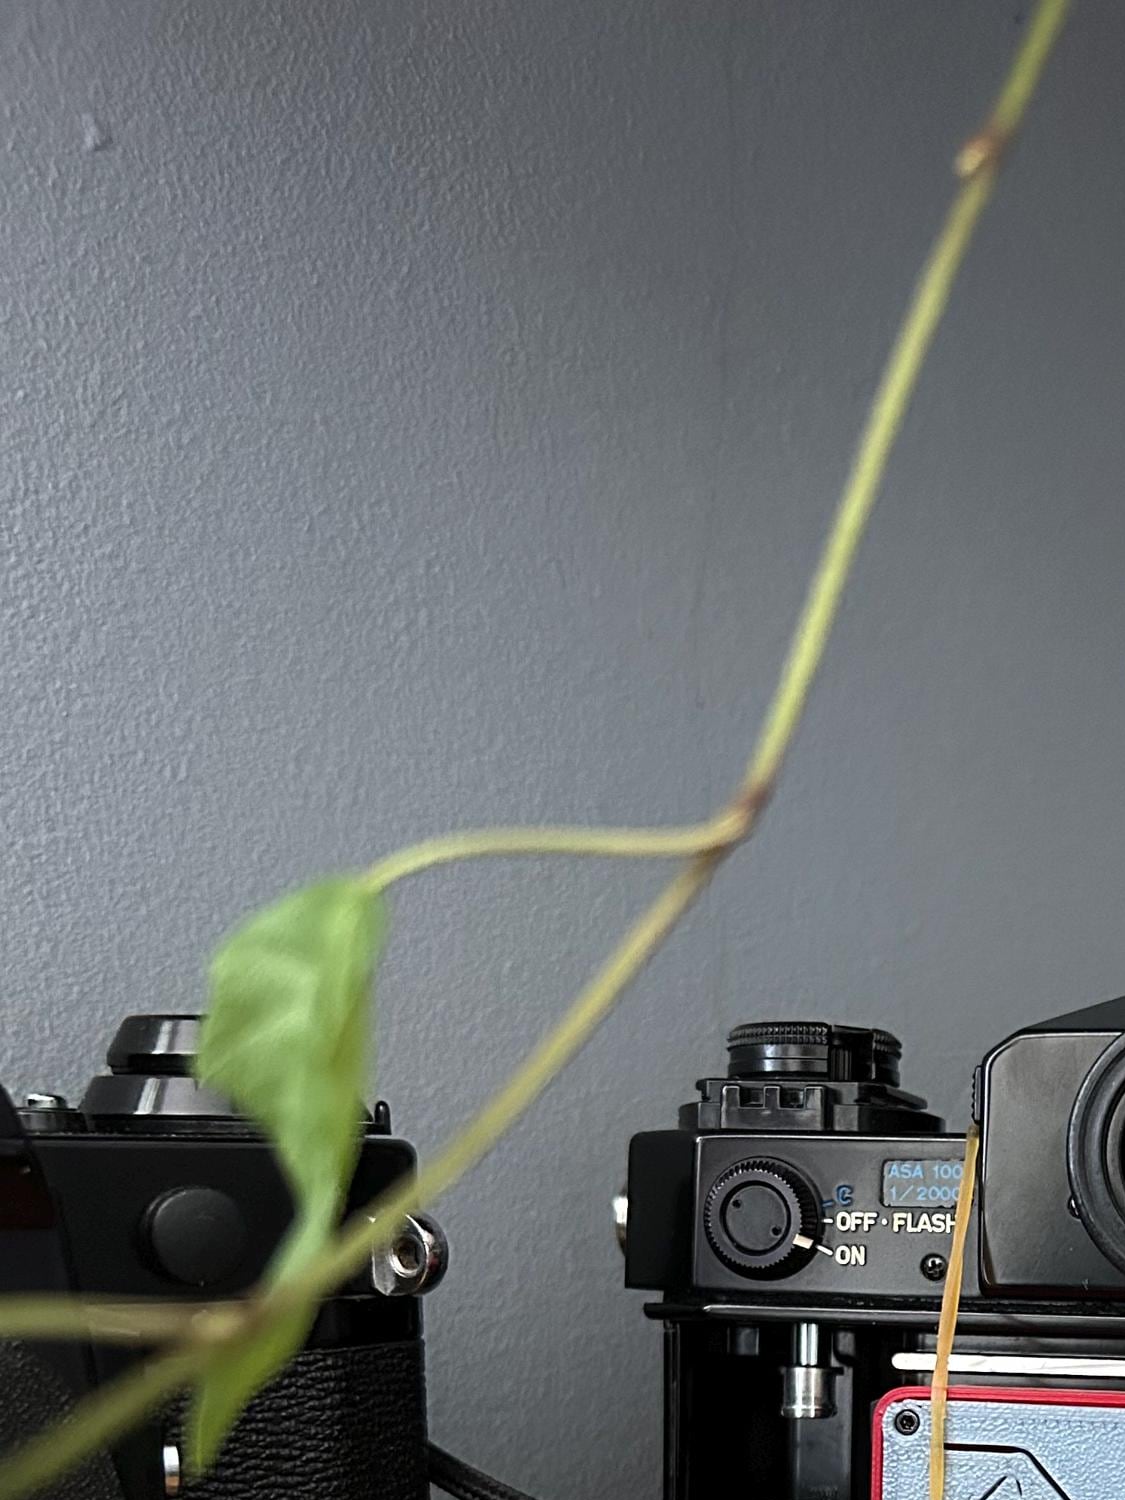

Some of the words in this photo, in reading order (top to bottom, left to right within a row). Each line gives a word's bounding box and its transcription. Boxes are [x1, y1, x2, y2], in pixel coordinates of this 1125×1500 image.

[889, 1164, 923, 1179] ASA
[932, 1164, 963, 1179] 100
[836, 1211, 878, 1232] OFF
[835, 1245, 866, 1265] ON
